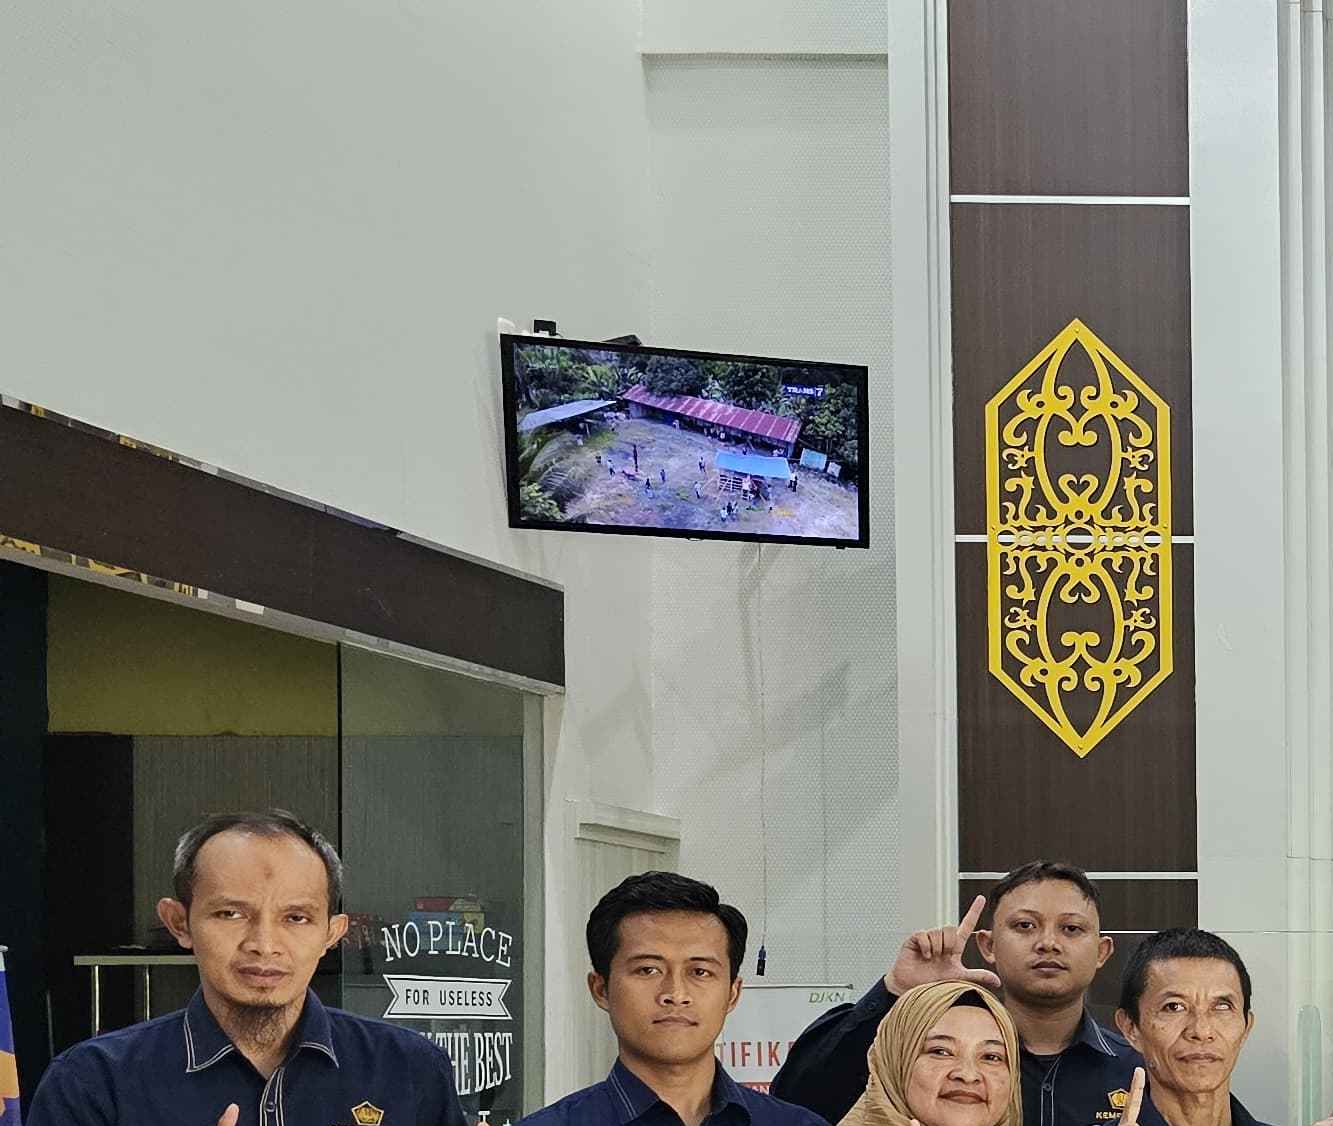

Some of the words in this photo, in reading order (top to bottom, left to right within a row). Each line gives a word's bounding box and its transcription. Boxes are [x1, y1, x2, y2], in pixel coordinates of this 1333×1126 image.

[381, 921, 420, 962] NO
[427, 920, 513, 968] PLACE
[405, 988, 430, 1006] FOR
[439, 990, 493, 1007] USELESS
[809, 992, 846, 1003] DJKN
[473, 1032, 513, 1093] BEST
